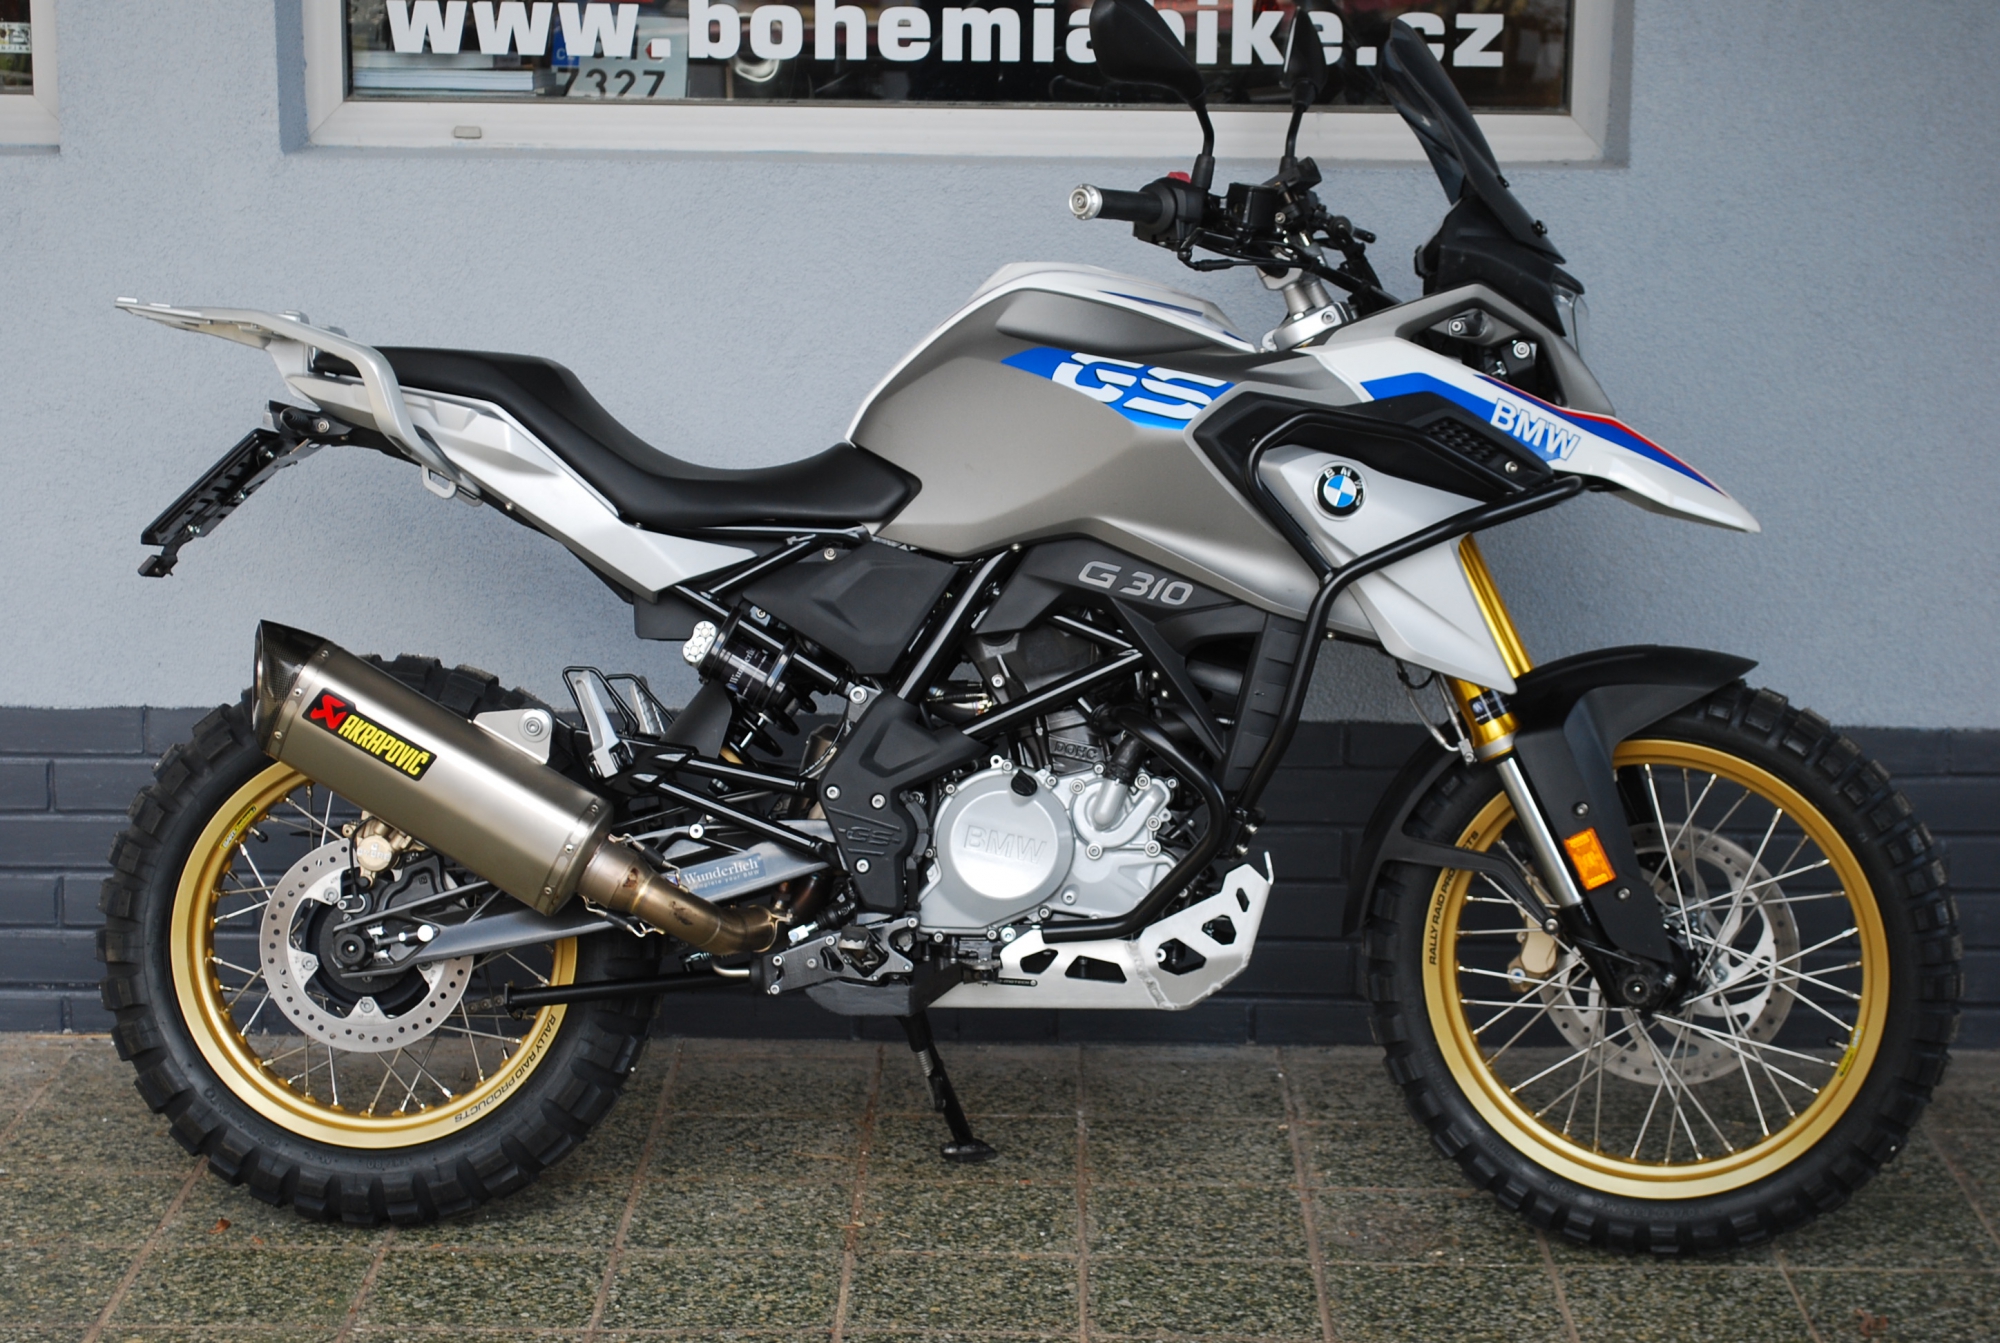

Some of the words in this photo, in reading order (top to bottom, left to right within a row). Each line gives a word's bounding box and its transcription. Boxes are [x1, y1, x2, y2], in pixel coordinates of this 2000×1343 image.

[386, 0, 1504, 67] www.bohemiik.z
[1052, 352, 1228, 420] GS
[1490, 397, 1581, 461] BMW
[1078, 560, 1122, 589] G
[1119, 571, 1194, 606] 310
[1055, 741, 1098, 760] DOHC
[964, 824, 1047, 865] BMW
[684, 858, 759, 885] Wunderlich
[1432, 893, 1446, 925] RAID
[1428, 925, 1438, 966] RALLY
[535, 1013, 556, 1053] RALLY
[515, 1051, 537, 1079] RAID
[454, 1078, 516, 1123] PRODUCTS
